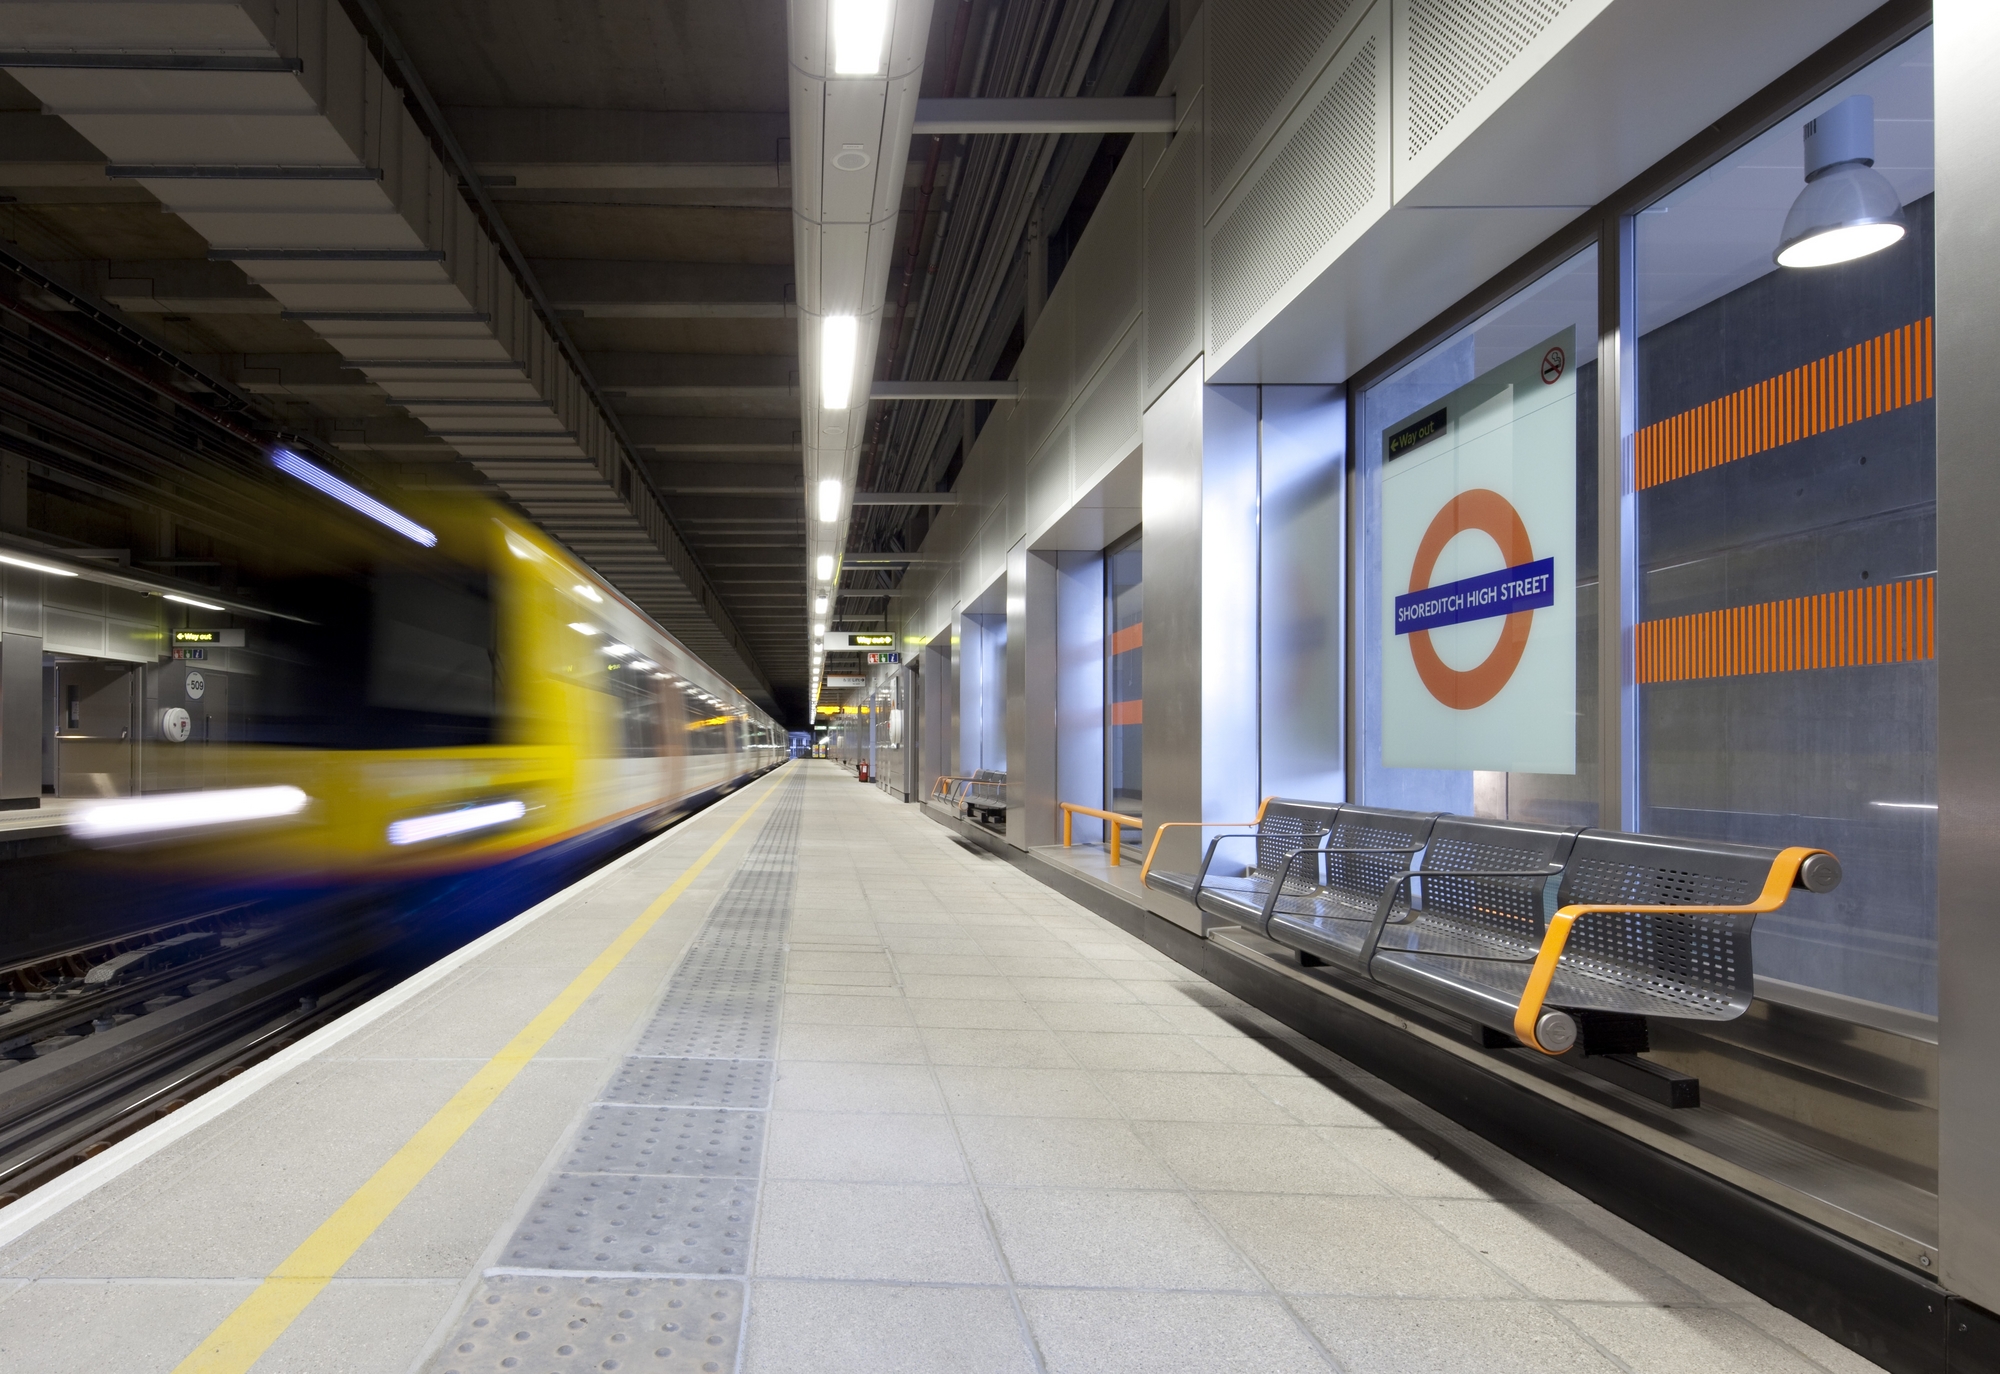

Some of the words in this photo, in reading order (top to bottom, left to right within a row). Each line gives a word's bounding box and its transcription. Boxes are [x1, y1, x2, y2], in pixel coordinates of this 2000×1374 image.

[1399, 431, 1417, 448] Way
[1418, 421, 1435, 438] out
[1398, 593, 1464, 622] SHOREDITCH
[1467, 586, 1497, 608] HIGH
[1500, 574, 1549, 601] STREET
[184, 633, 199, 641] Way
[856, 636, 871, 645] Way
[871, 636, 885, 644] out
[190, 680, 204, 691] 509
